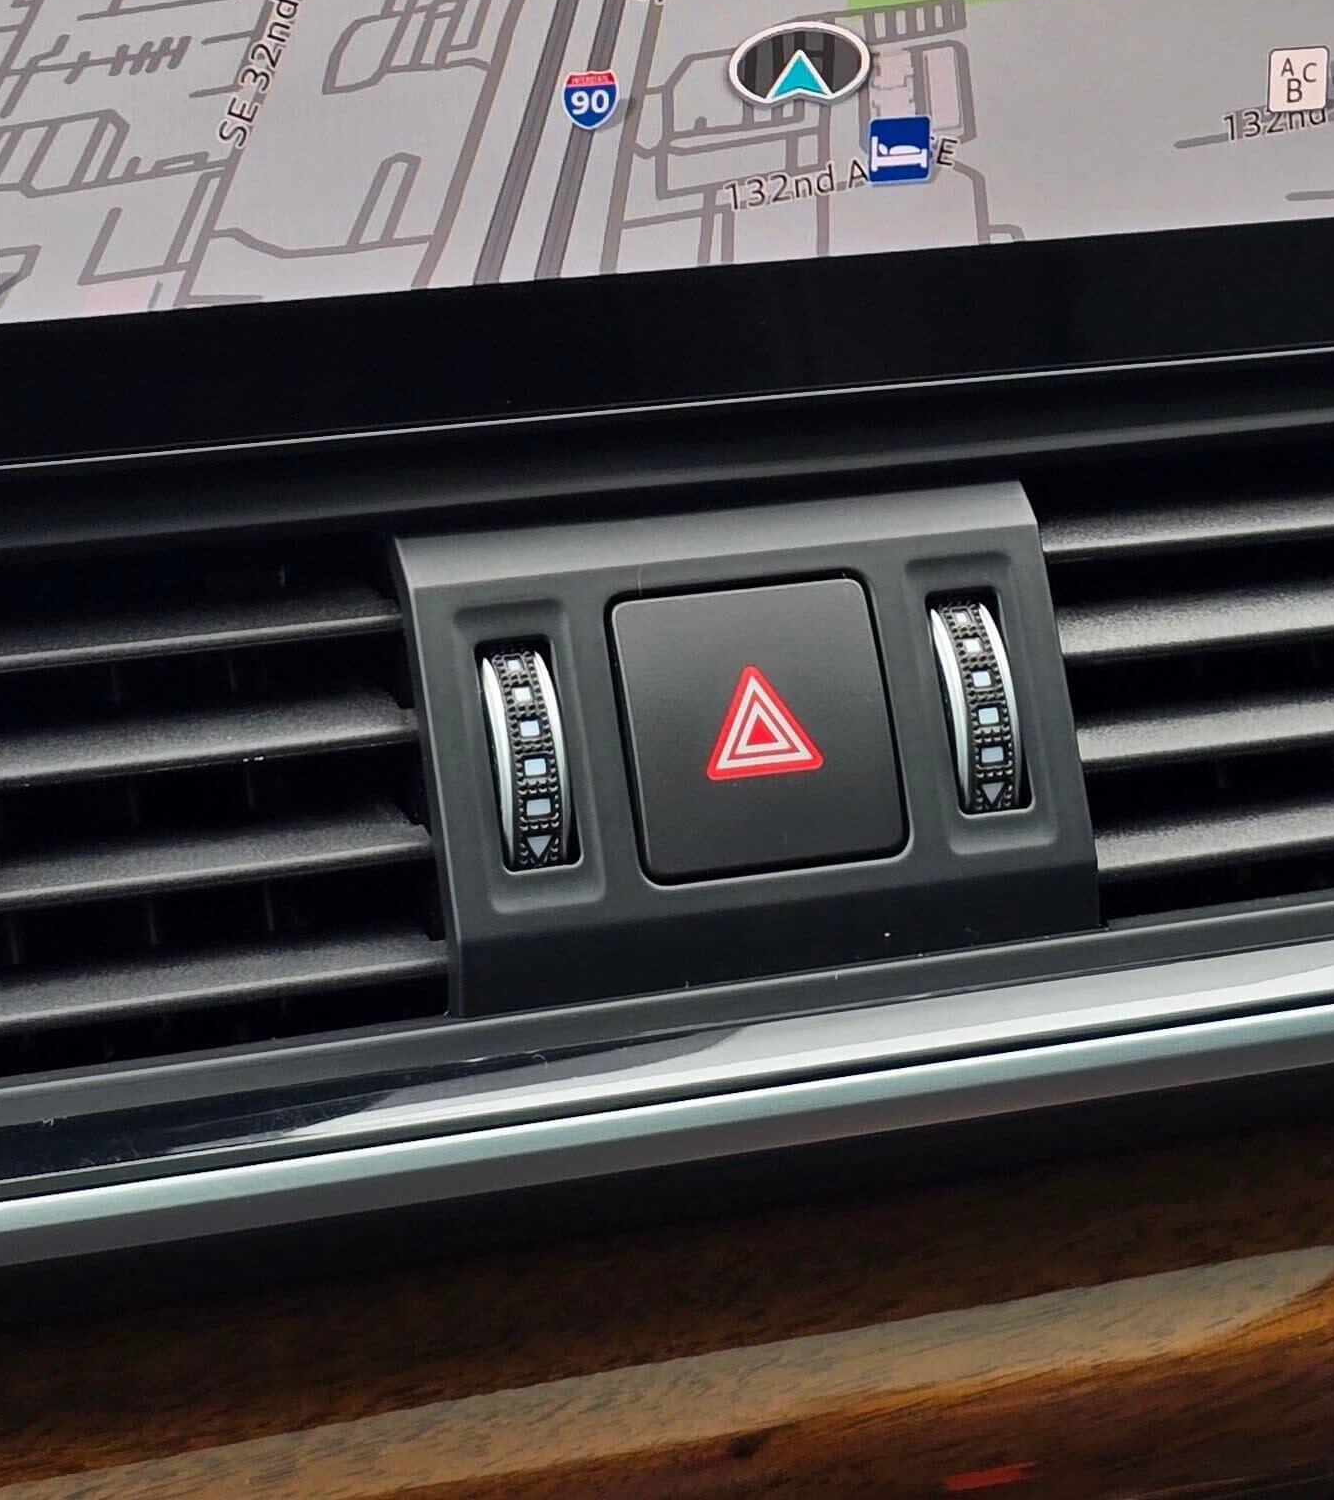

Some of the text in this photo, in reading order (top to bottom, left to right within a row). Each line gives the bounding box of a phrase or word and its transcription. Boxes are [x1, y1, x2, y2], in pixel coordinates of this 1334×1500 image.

[218, 96, 260, 148] SE
[570, 88, 610, 116] 90
[723, 163, 836, 210] 132nd
